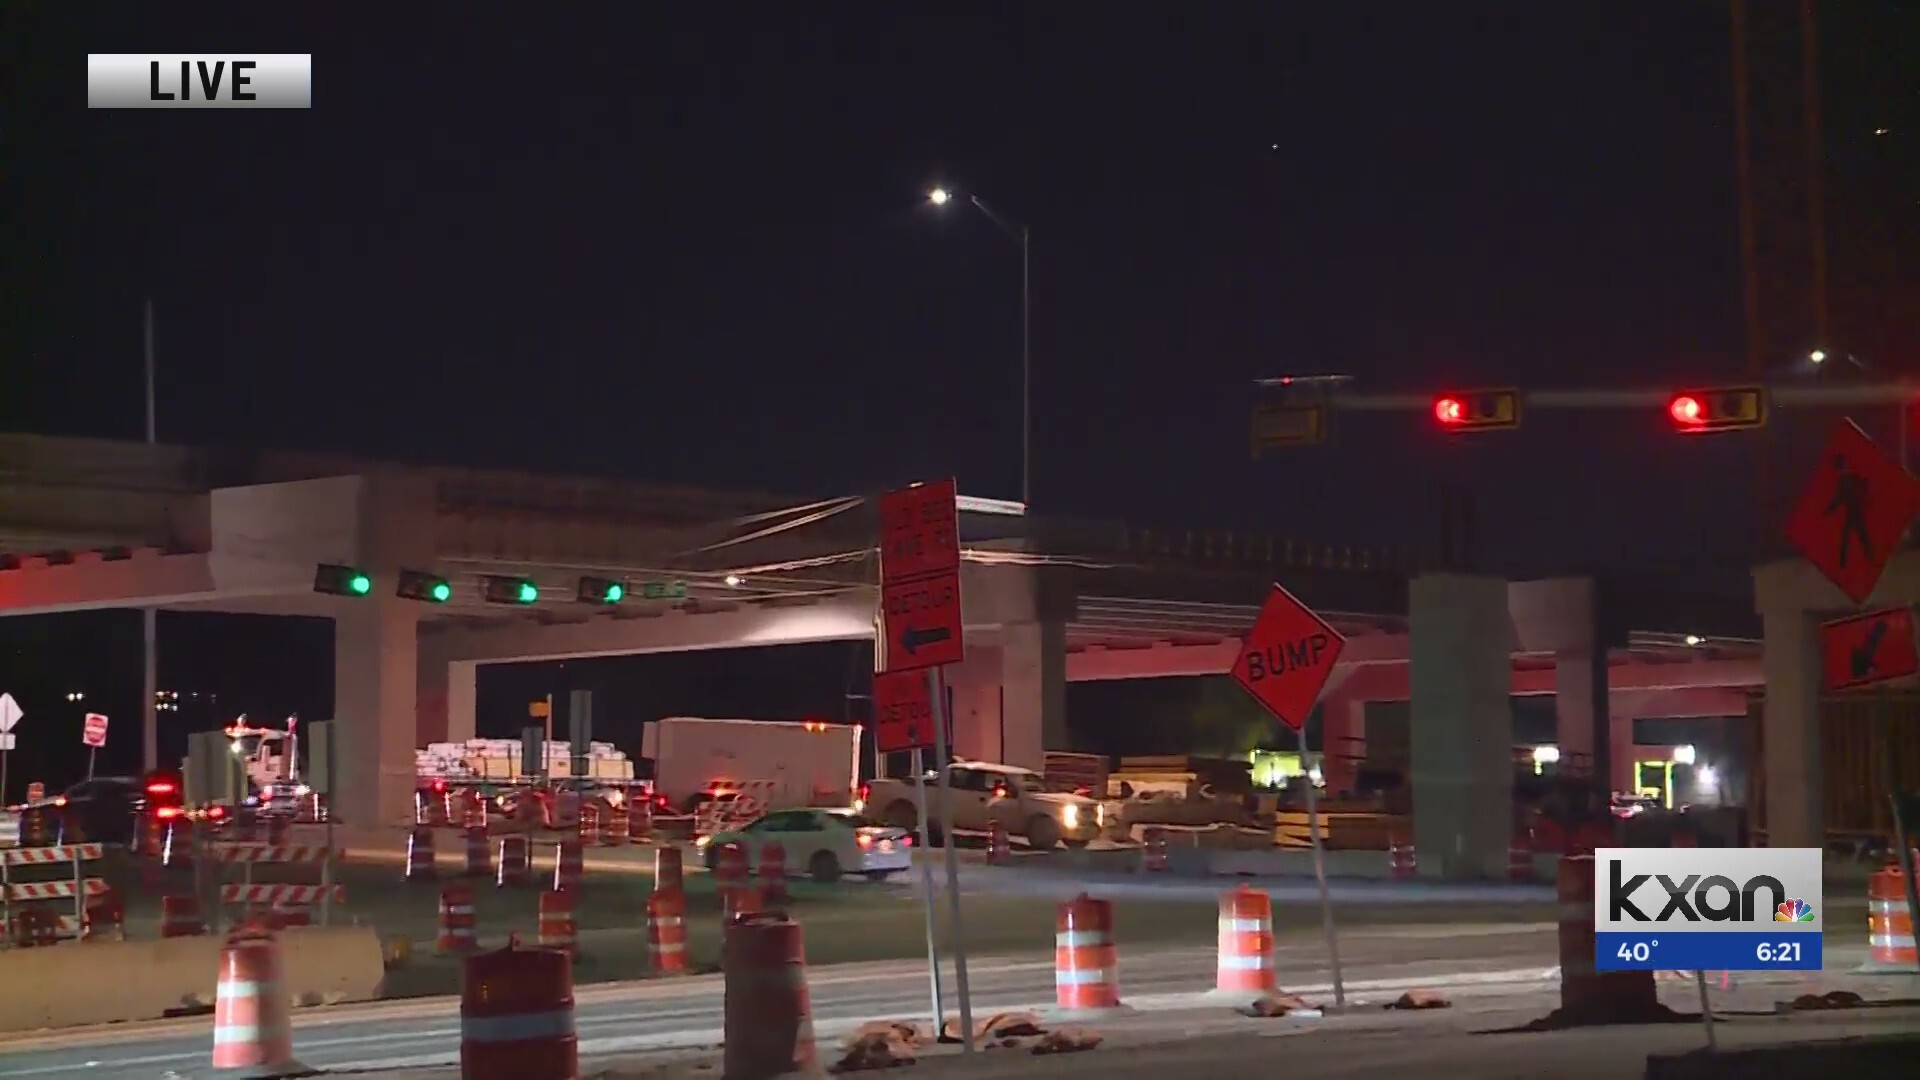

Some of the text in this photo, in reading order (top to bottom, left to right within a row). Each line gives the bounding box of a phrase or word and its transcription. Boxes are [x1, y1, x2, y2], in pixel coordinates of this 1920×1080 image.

[889, 585, 953, 616] DETOUR
[1247, 633, 1328, 682] BUMP
[879, 702, 931, 724] DETOU
